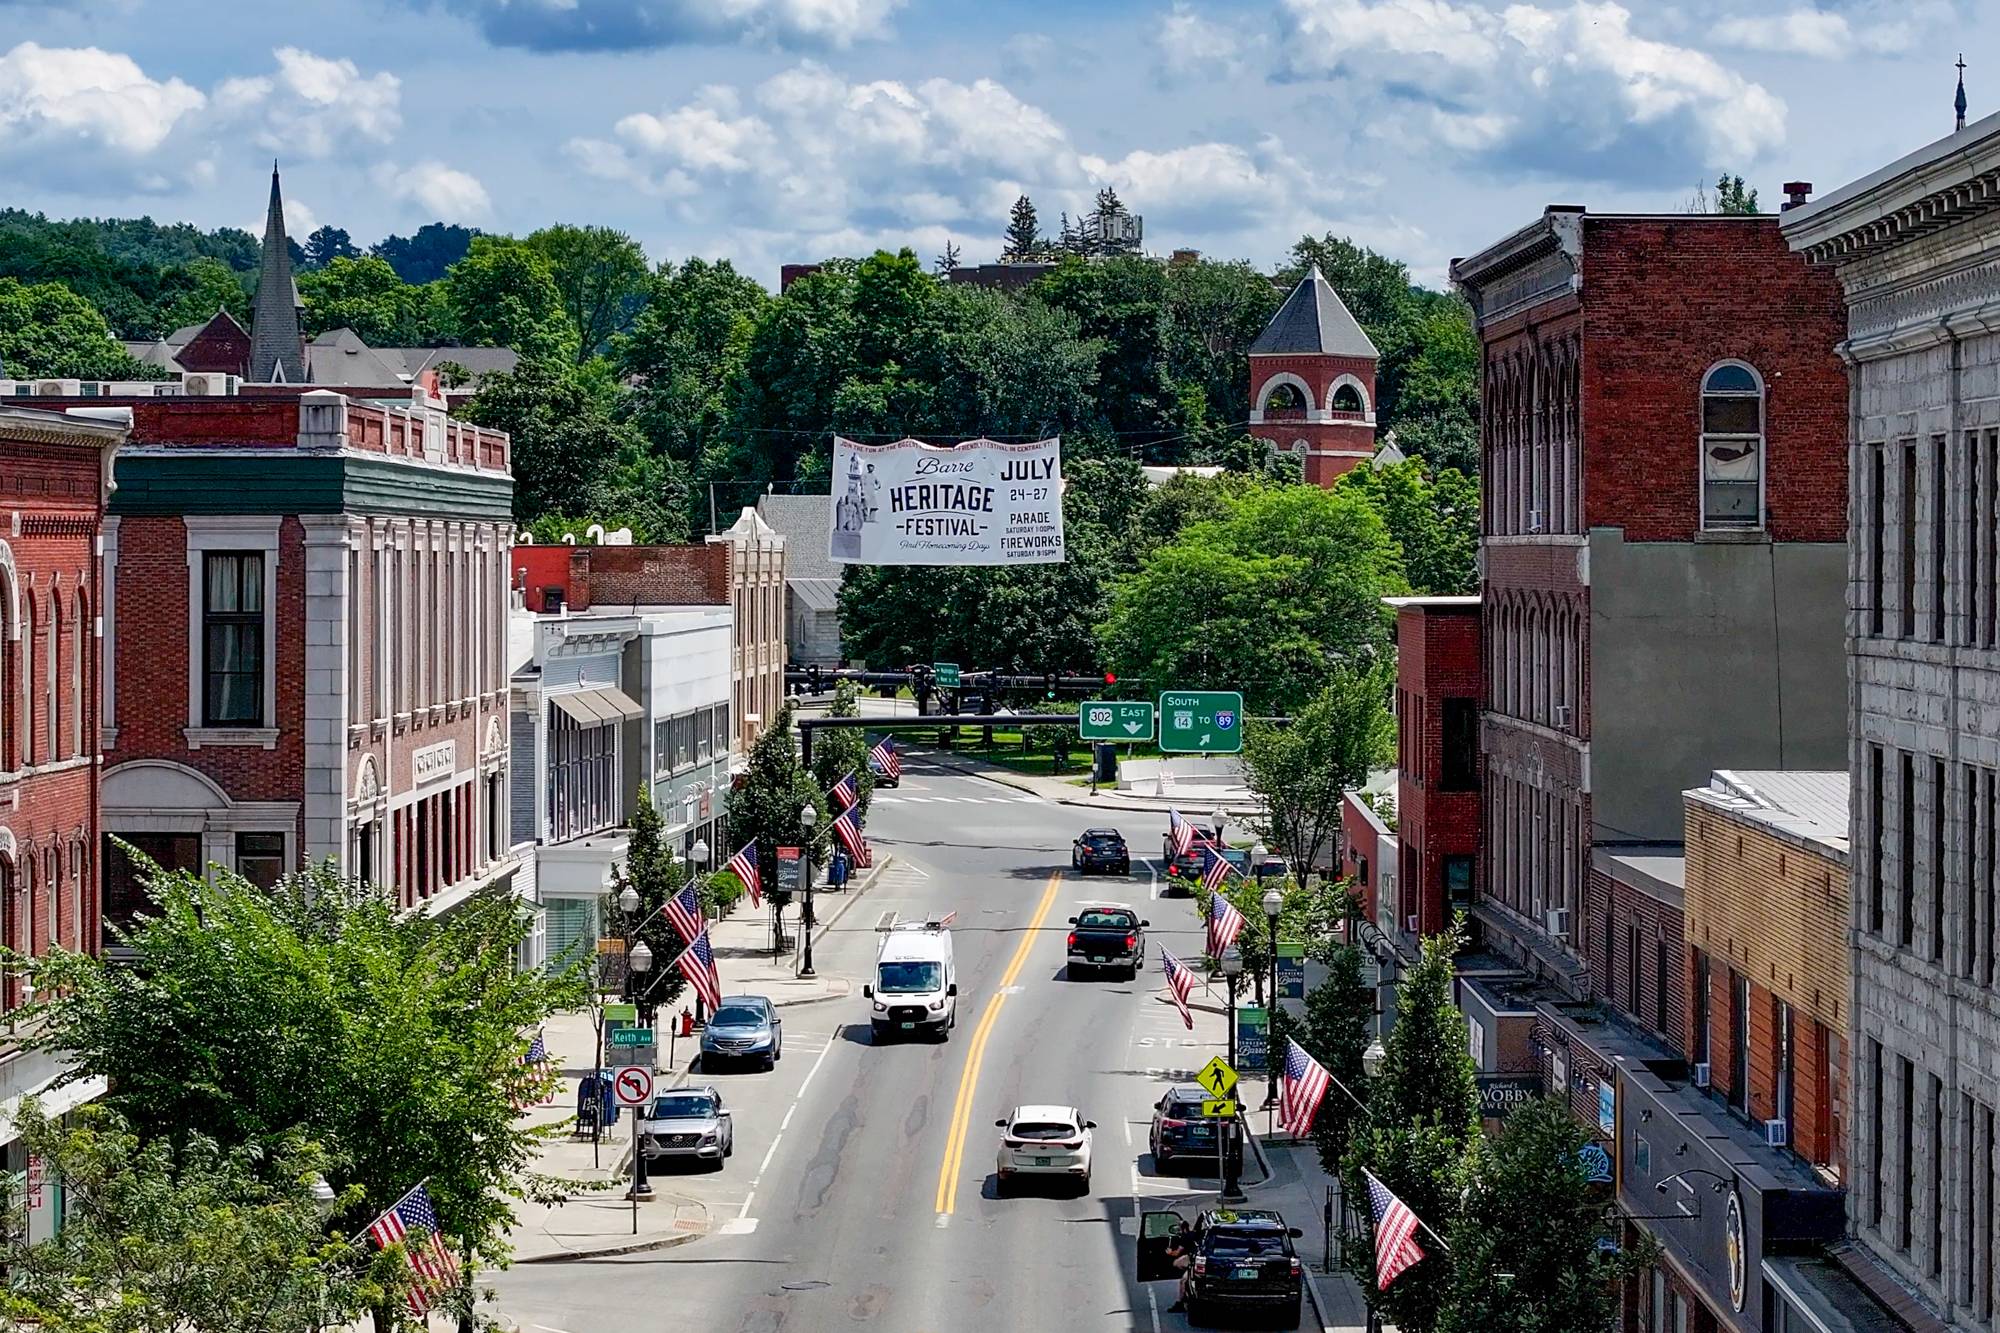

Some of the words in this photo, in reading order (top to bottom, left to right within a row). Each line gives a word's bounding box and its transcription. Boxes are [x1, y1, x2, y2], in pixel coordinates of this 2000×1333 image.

[1017, 444, 1041, 452] CENTRAL
[915, 457, 974, 475] Barre
[1001, 457, 1055, 481] JULY
[890, 484, 995, 513] HERITAGE
[1010, 488, 1048, 501] 24-27
[1010, 512, 1050, 525] PARADE
[1006, 526, 1034, 534] SATURDAY
[900, 540, 917, 549] And
[919, 539, 967, 552] Homecoming
[967, 540, 990, 552] Days
[1000, 535, 1062, 549] FIREWORKS
[1006, 550, 1035, 558] SATURDAY
[1090, 712, 1111, 722] 302
[1177, 718, 1188, 727] 14
[1198, 716, 1211, 724] TO
[1218, 717, 1232, 726] 89
[614, 1033, 637, 1042] Keith
[1238, 1045, 1267, 1056] Barre
[1477, 1089, 1533, 1102] WOBBY
